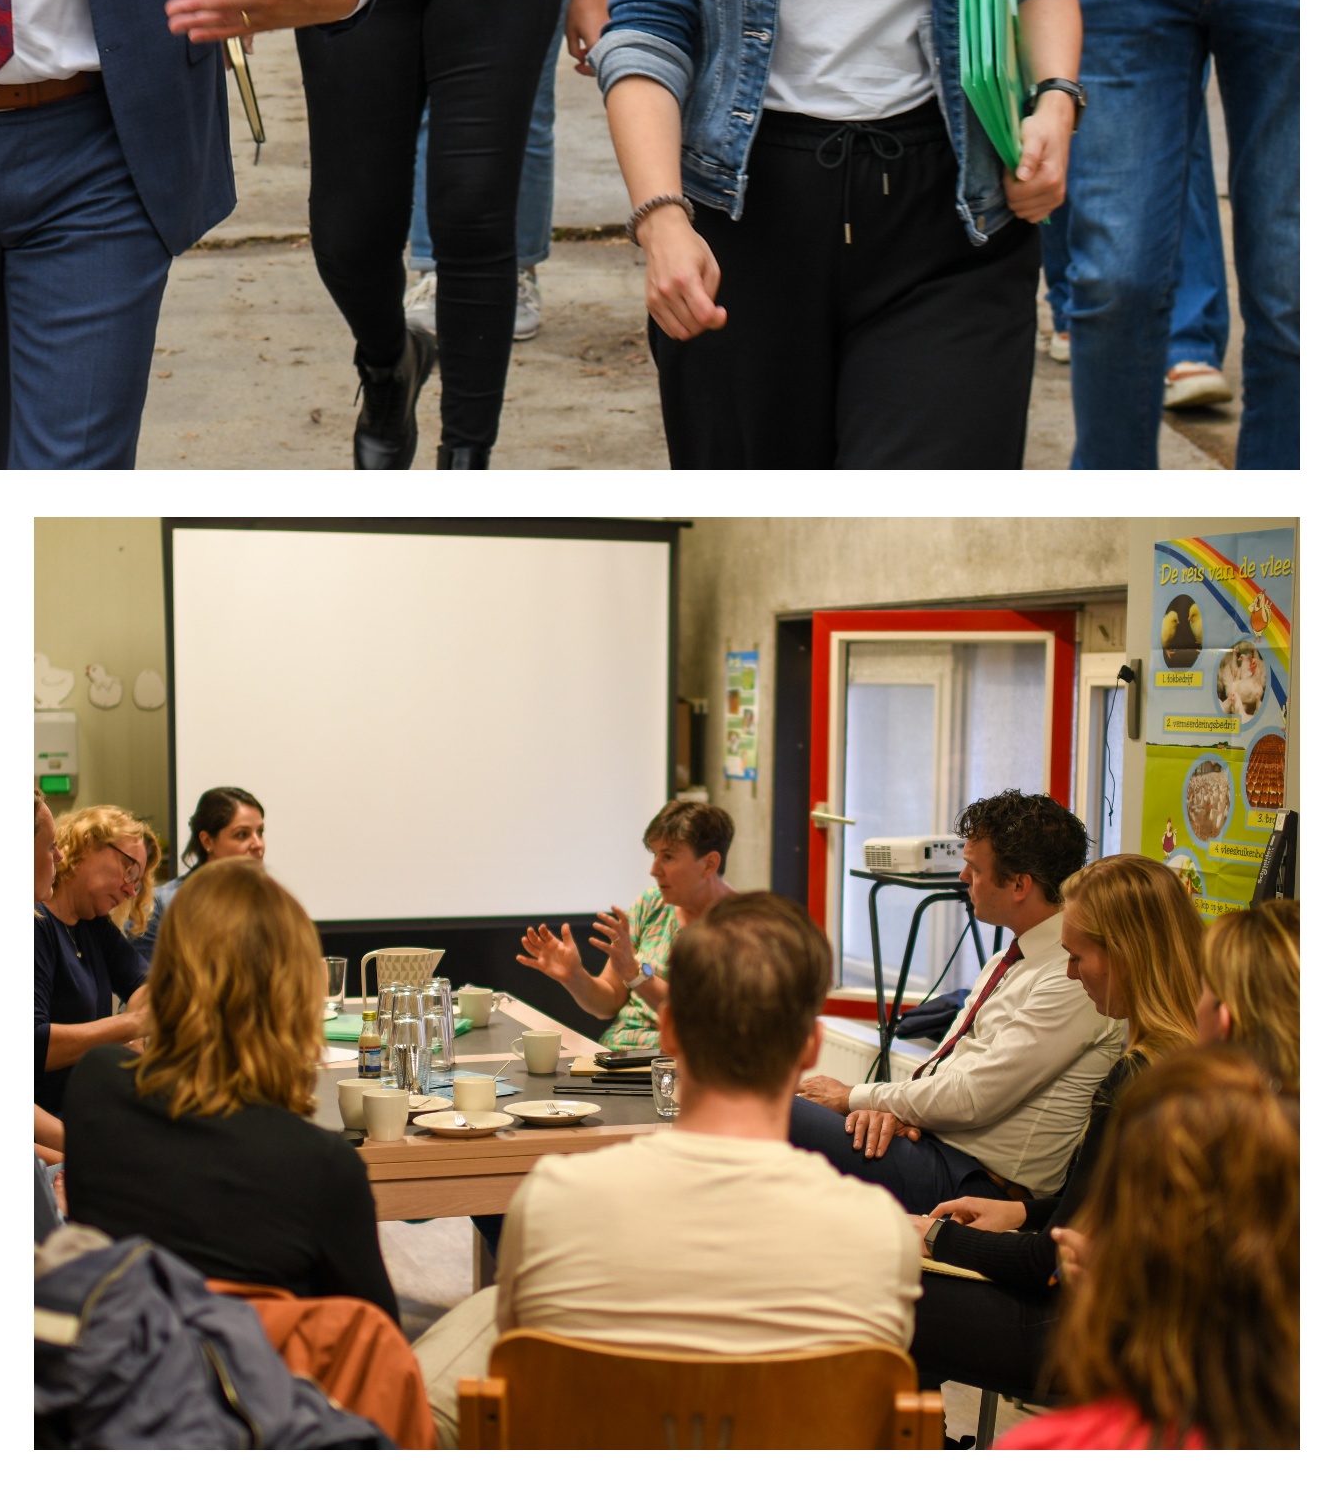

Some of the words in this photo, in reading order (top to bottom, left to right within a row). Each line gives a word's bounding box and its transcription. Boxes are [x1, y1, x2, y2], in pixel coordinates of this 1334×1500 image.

[1160, 563, 1178, 585] De
[1181, 562, 1204, 583] reis
[1208, 564, 1235, 581] van
[1240, 556, 1256, 579] de
[1167, 674, 1194, 685] fokbedrijf
